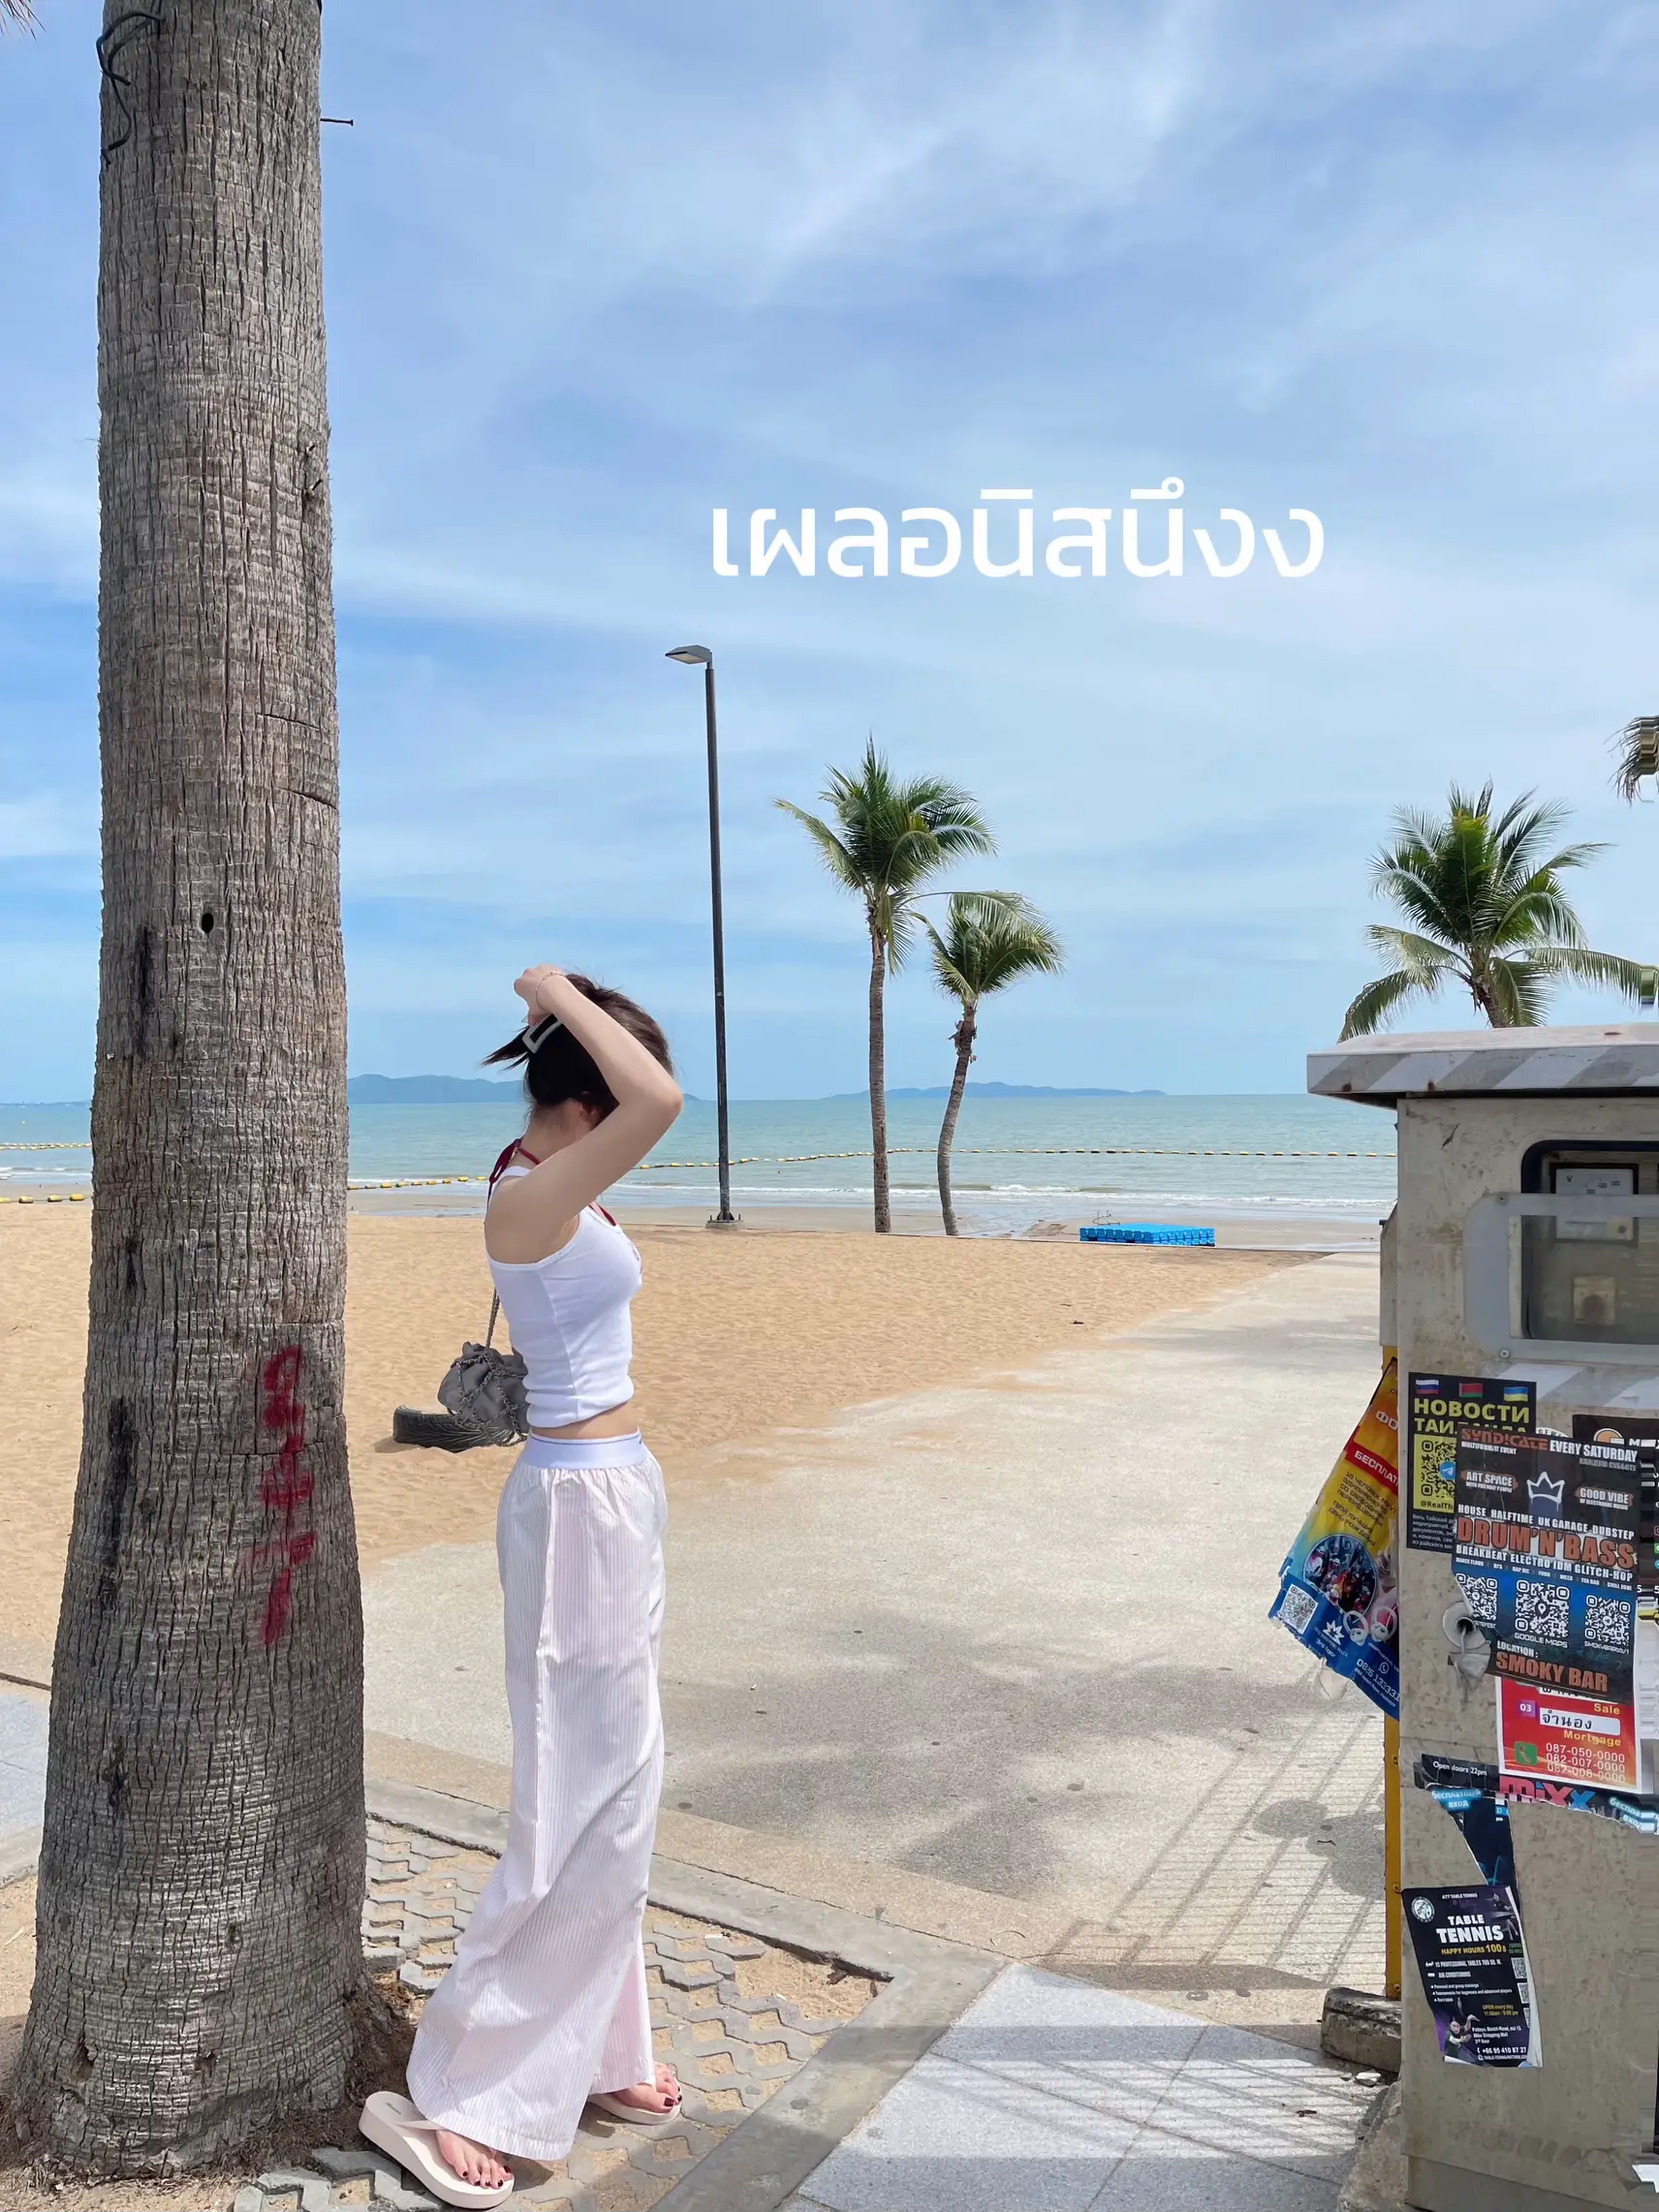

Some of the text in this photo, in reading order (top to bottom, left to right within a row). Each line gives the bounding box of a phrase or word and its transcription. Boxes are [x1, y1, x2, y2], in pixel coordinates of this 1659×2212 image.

[1414, 1397, 1530, 1424] НОВОСТИ
[1550, 1440, 1639, 1463] EVERY SATURDAY
[1466, 1471, 1513, 1486] ART SPACE
[1580, 1488, 1606, 1501] GOOD
[1457, 1504, 1635, 1541] HOUSE HALFTIME UK GARAGE DUBSTEP
[1456, 1516, 1637, 1571] DRUM'N'BASS
[1456, 1544, 1634, 1582] BREAKBEAT ELECTRO IDM GLITCH-HOP
[1515, 1632, 1568, 1649] GOOGLE MAPS
[1495, 1651, 1609, 1693] SMOKY BAR
[1519, 1703, 1532, 1712] 03
[1593, 1702, 1621, 1715] Sale
[1542, 1710, 1592, 1729] จำนอง
[1564, 1729, 1621, 1747] Mortgage
[1546, 1742, 1625, 1763] 087-050-0000
[1432, 1760, 1487, 1777] Open doors 22pm
[1546, 1753, 1626, 1773] 082-007-0000
[1448, 1799, 1469, 1810] вход
[1448, 1915, 1485, 1926] TABLE
[1436, 1925, 1504, 1944] TENNIS
[1486, 1944, 1502, 1953] 100
